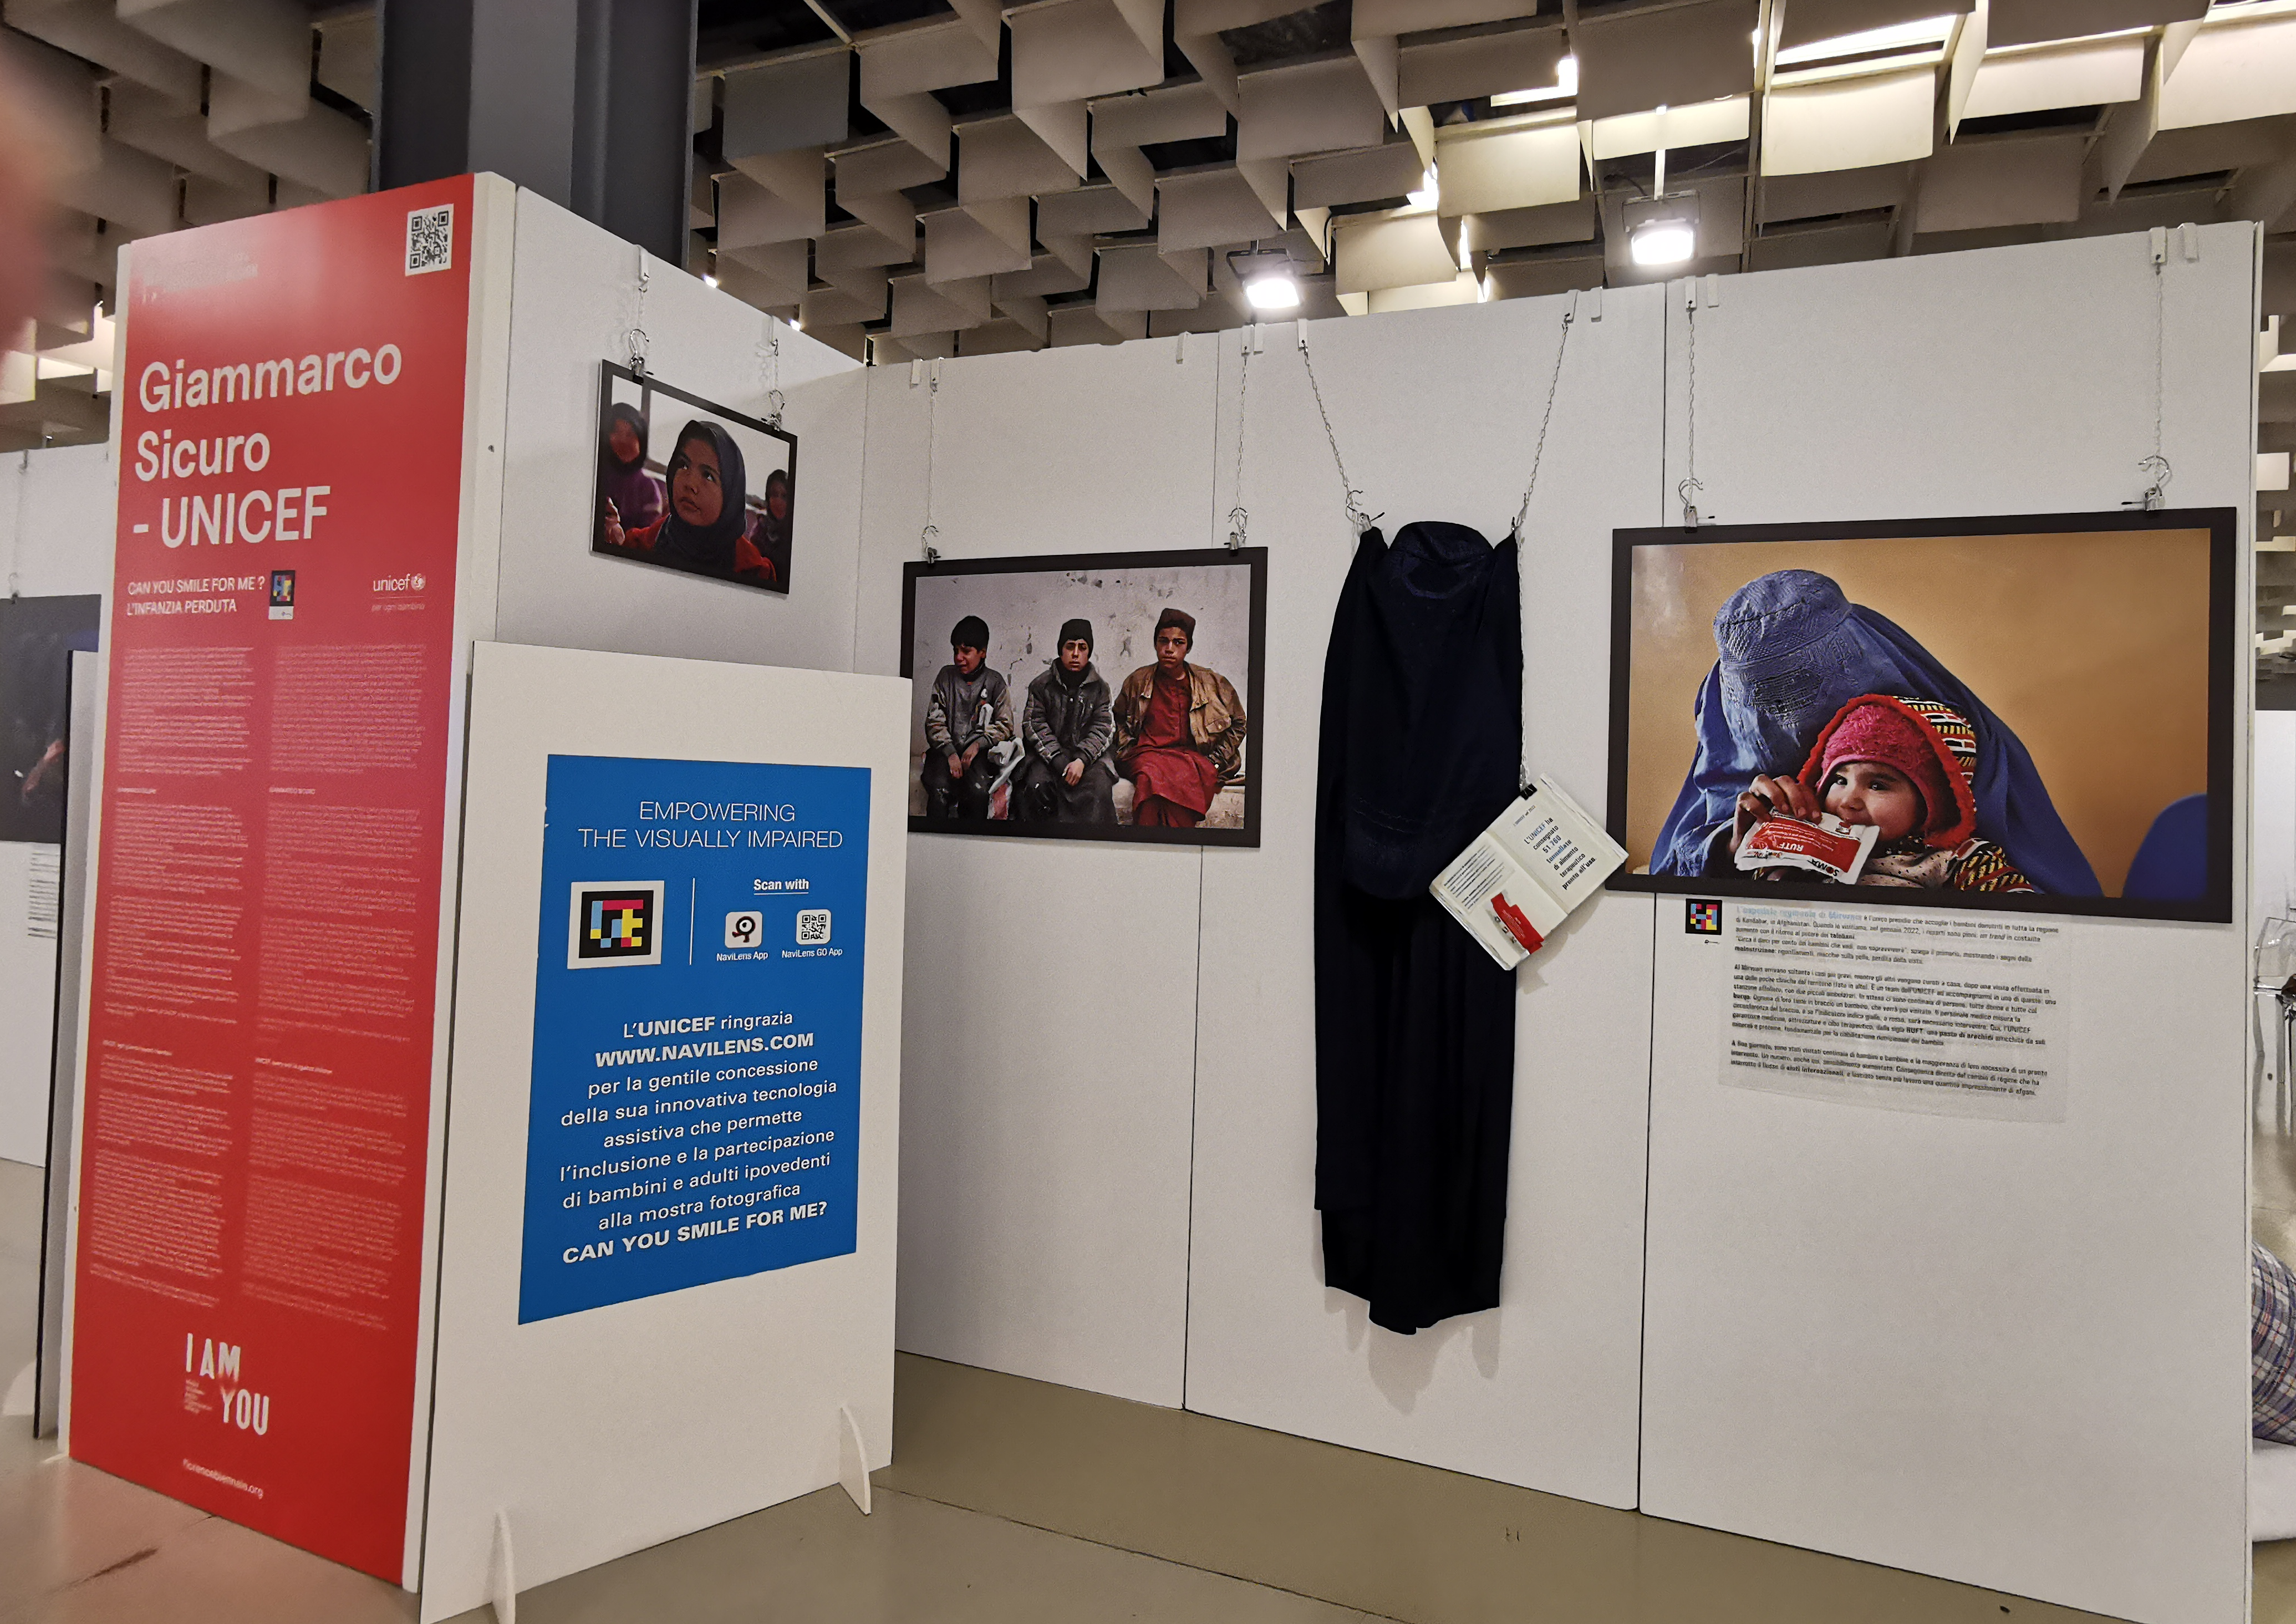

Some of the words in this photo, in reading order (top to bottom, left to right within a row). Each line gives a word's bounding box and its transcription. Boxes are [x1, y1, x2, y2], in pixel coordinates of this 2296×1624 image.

[139, 343, 401, 414] Giammarco
[135, 429, 271, 481] Sicuro
[162, 486, 330, 548] UNICEF
[128, 581, 150, 595] CAN
[152, 579, 174, 593] YOU
[176, 578, 209, 593] SMILE
[212, 578, 235, 592] FOR
[237, 577, 254, 590] ME
[373, 573, 410, 591] unicef
[127, 601, 182, 616] L'INFANZIA
[185, 599, 237, 613] PERDUTA
[640, 802, 795, 821] EMPOWERING
[578, 829, 627, 847] THE
[635, 829, 741, 847] VISUALLY
[749, 831, 842, 847] IMPAIRED
[1524, 823, 1545, 844] L'UNICEF
[1533, 825, 1559, 850] consegnato
[1546, 840, 1572, 863] tonnellate
[1559, 847, 1579, 866] alimento
[1779, 842, 1804, 851] RUTF
[1560, 853, 1586, 878] terapeutico
[754, 879, 781, 890] Scan
[785, 879, 809, 889] with
[1562, 872, 1579, 890] pronto
[753, 951, 768, 960] App
[829, 948, 842, 956] App
[624, 1016, 715, 1037] L'UNICEF
[721, 1011, 792, 1030] ringrazia
[595, 1033, 814, 1068] WWW.NAVILENS.COM
[589, 1082, 620, 1099] per
[627, 1077, 642, 1091] la
[649, 1070, 710, 1091] gentile
[716, 1060, 817, 1081] concessione
[561, 1107, 608, 1126] della
[615, 1105, 647, 1119] sua
[656, 1092, 746, 1114] innovativa
[753, 1080, 836, 1102] tecnologia
[604, 1126, 684, 1147] assistiva
[691, 1120, 721, 1135] che
[727, 1111, 802, 1135] permette
[561, 1155, 671, 1183] l'inclusione
[677, 1153, 687, 1163] e
[694, 1147, 707, 1160] la
[715, 1131, 834, 1162] partecipazione
[563, 1192, 580, 1208] di
[589, 1178, 666, 1204] bambini
[674, 1179, 683, 1190] e
[689, 1167, 738, 1187] adulti
[745, 1152, 829, 1181] ipovedenti
[599, 1212, 632, 1230] alla
[640, 1202, 702, 1222] mostra
[710, 1184, 800, 1209] fotografica
[563, 1240, 613, 1263] CAN
[622, 1230, 669, 1252] YOU
[677, 1217, 739, 1241] SMILE
[747, 1210, 783, 1229] FOR
[790, 1202, 827, 1220] ME?
[186, 1333, 193, 1372] I
[199, 1338, 241, 1383] AM
[220, 1386, 269, 1435] YOU
